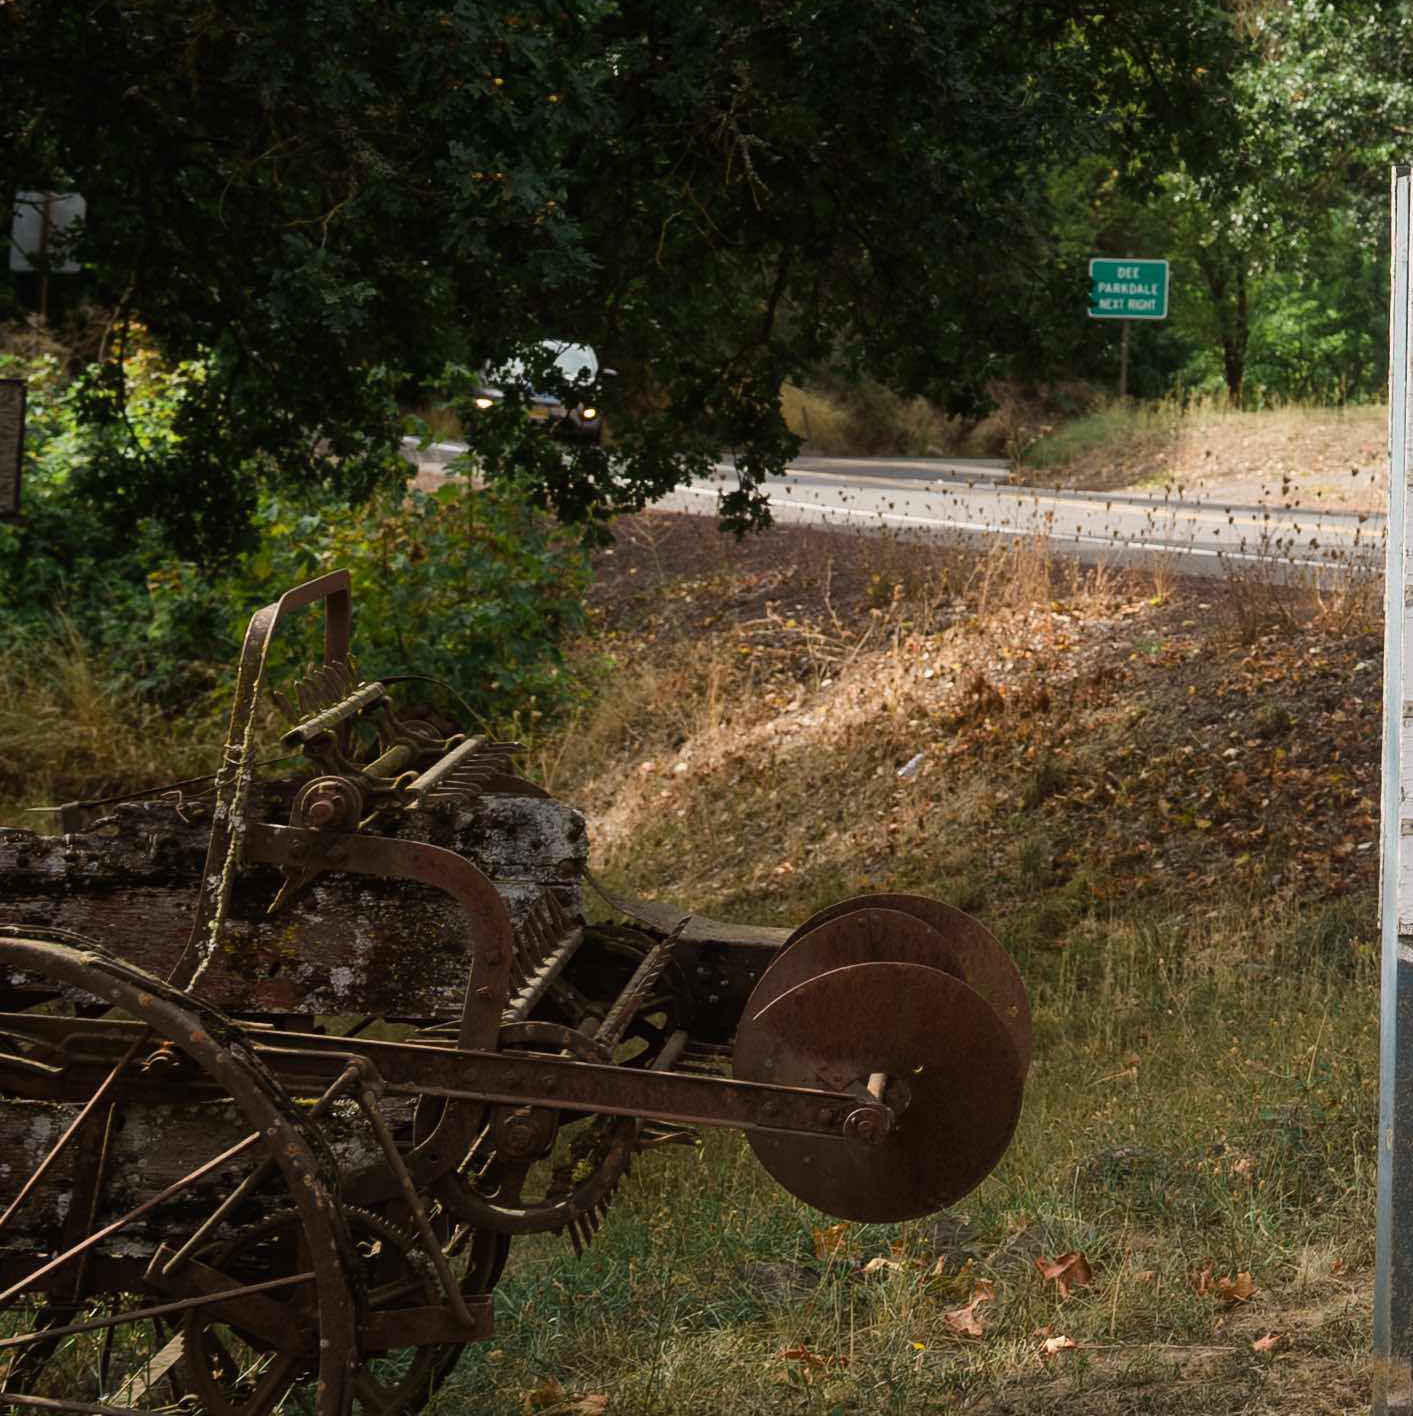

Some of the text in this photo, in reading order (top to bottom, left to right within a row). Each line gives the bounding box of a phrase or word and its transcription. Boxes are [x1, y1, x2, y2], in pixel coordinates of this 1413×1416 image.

[1117, 266, 1140, 279] DEE
[1097, 281, 1159, 295] PARKDALE
[1099, 298, 1156, 311] NEXT RIGHT
